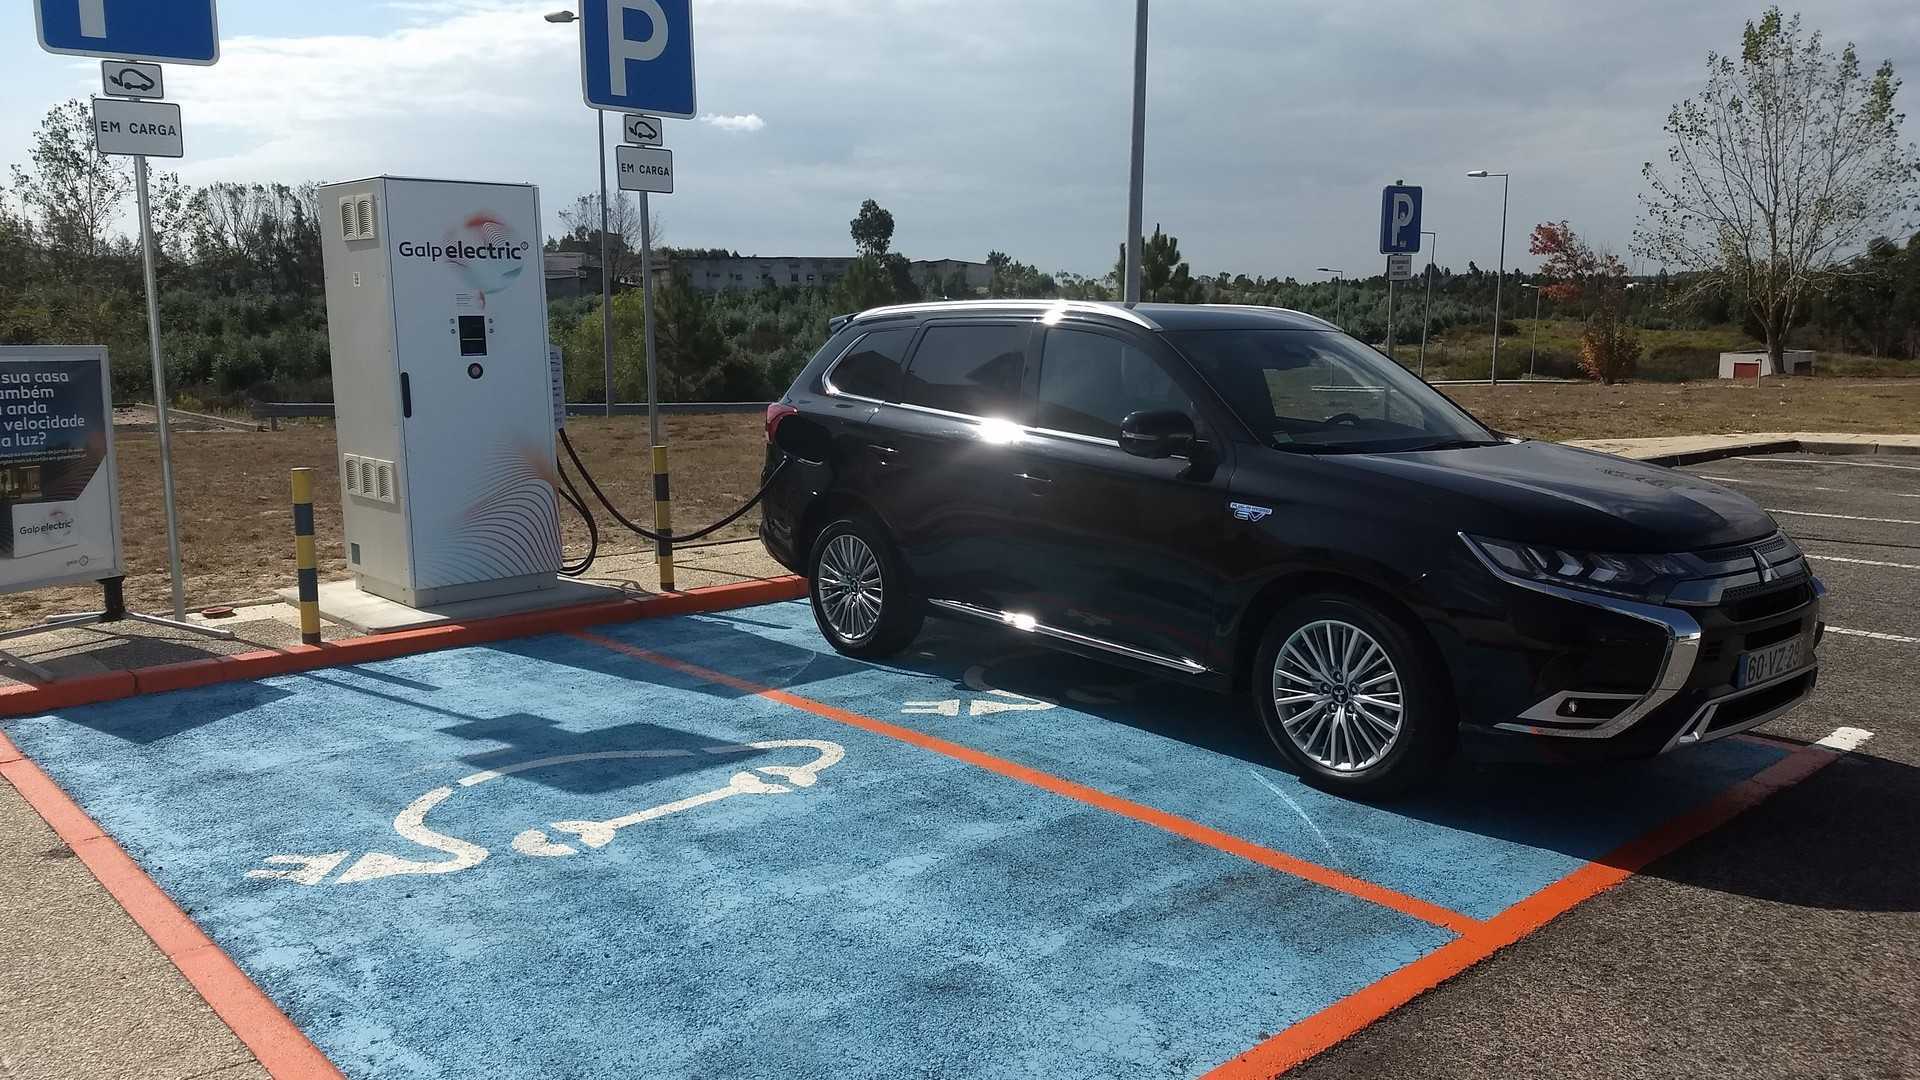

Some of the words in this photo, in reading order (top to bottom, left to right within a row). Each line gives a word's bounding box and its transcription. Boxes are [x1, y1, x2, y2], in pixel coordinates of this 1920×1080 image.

[607, 0, 669, 97] P
[100, 120, 121, 134] EM
[129, 122, 177, 137] CARGA
[621, 162, 635, 174] EM
[639, 164, 670, 177] CARGA
[1391, 192, 1415, 247] P
[398, 241, 443, 262] Galp
[445, 240, 523, 261] electric
[1, 372, 31, 385] sua
[34, 371, 70, 383] casa
[6, 400, 48, 416] anda
[3, 413, 86, 432] velocidade
[15, 431, 47, 447] luz?
